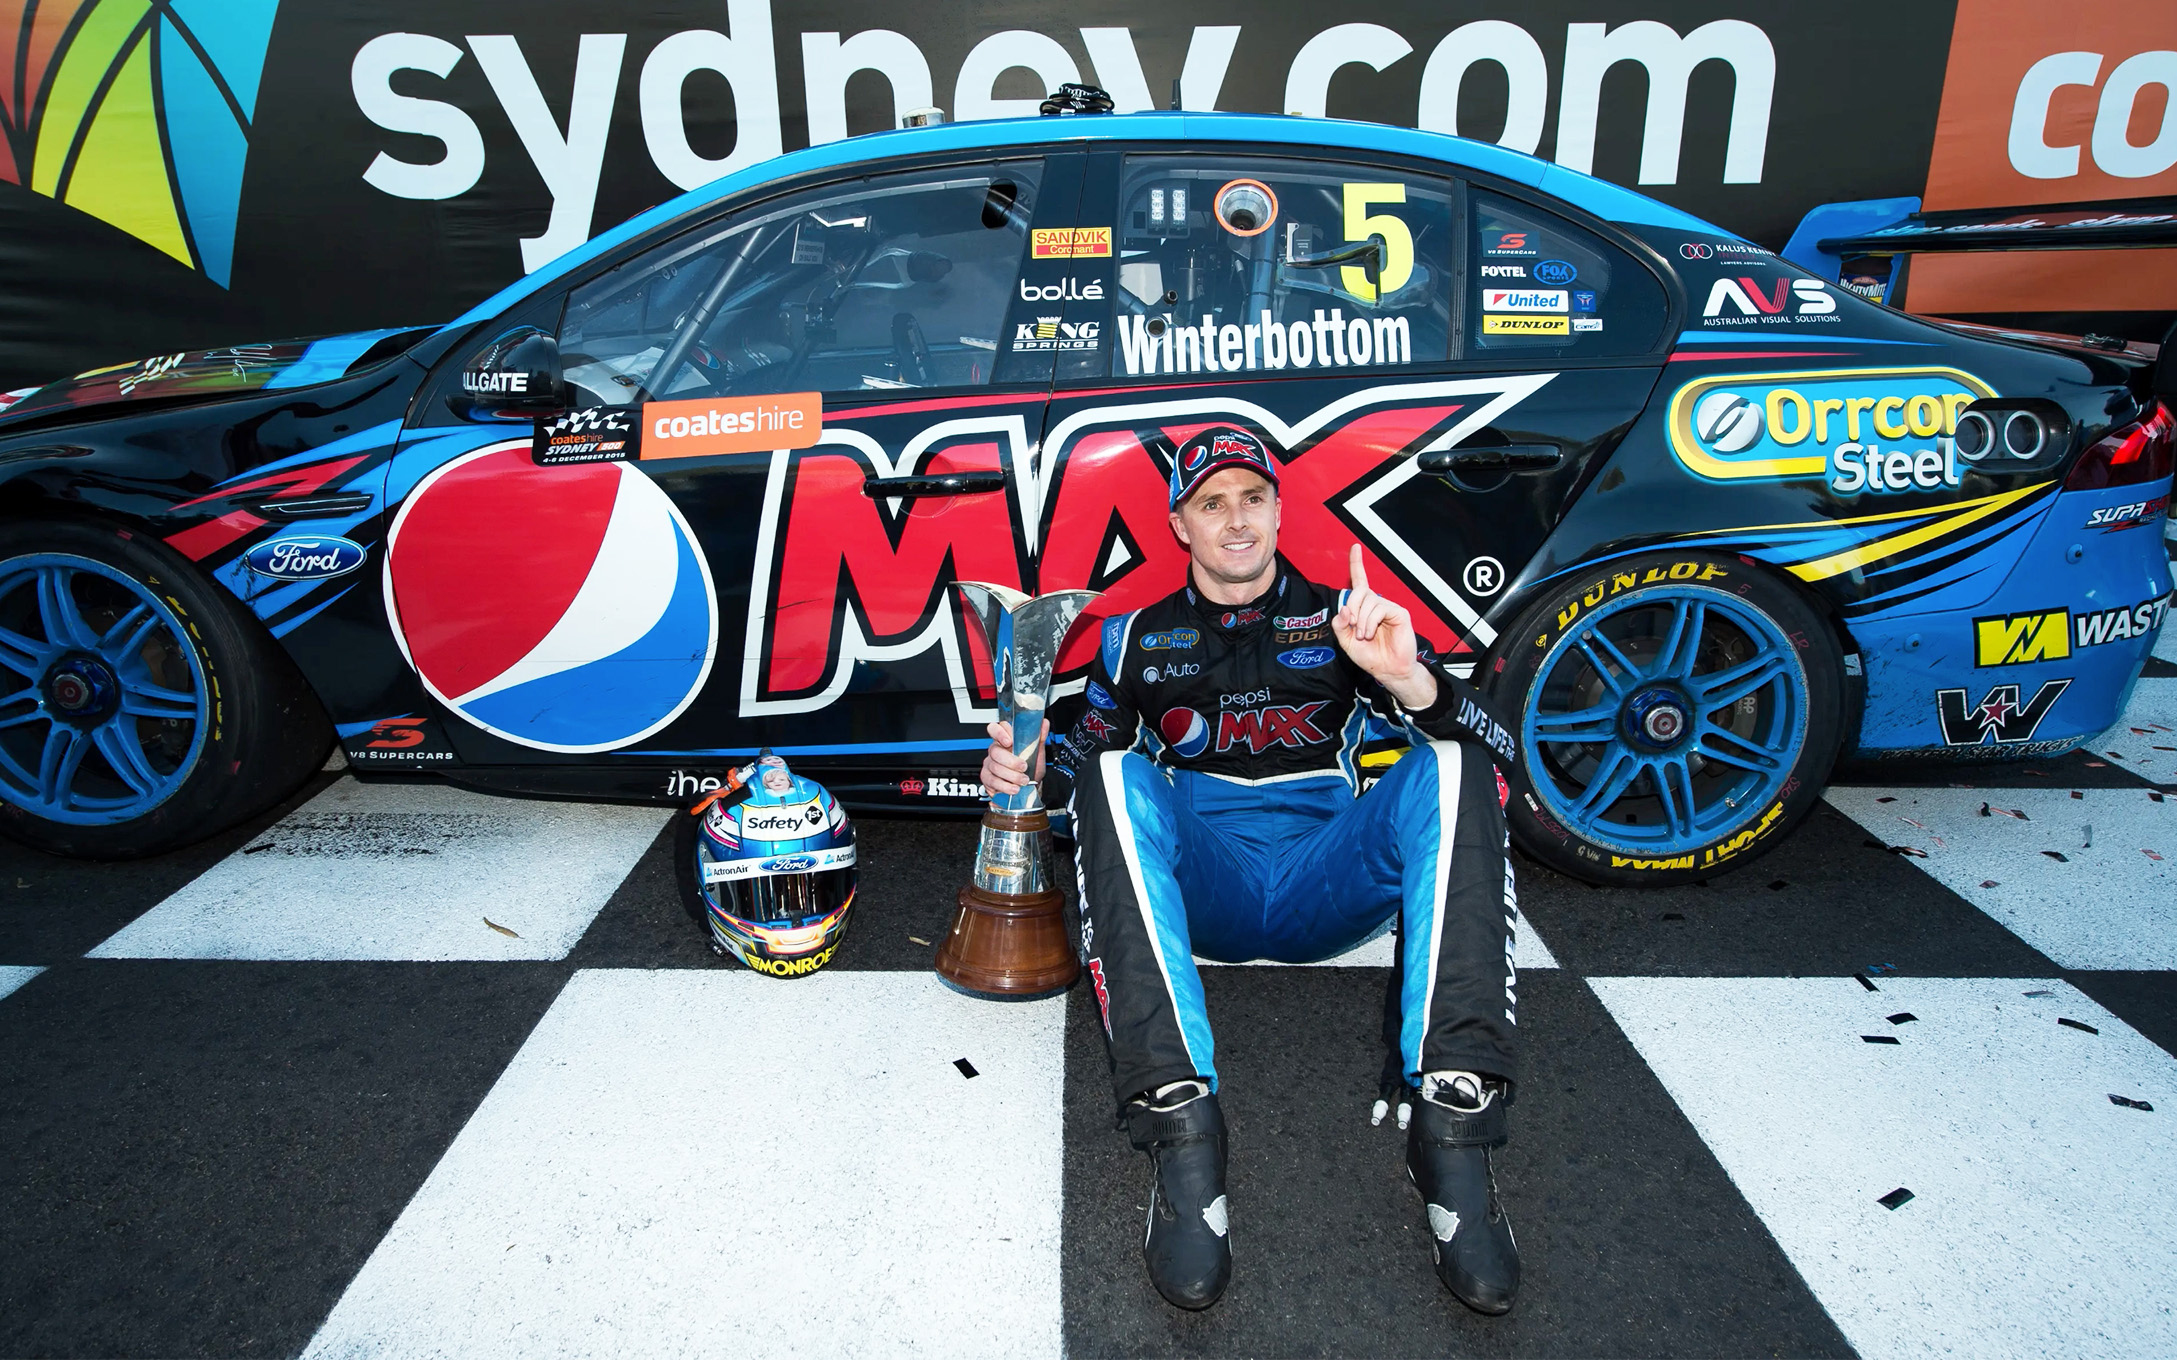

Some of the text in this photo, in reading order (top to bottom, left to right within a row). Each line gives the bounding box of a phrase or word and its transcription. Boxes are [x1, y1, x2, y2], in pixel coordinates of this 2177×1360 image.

[1036, 231, 1108, 244] SANDVIK
[1340, 183, 1416, 305] 5
[1050, 244, 1094, 254] Coromant
[1716, 244, 1747, 253] KALUS
[1481, 266, 1527, 277] FOXTEL
[1020, 277, 1104, 302] bollé
[1702, 277, 1837, 316] AVS
[1508, 293, 1560, 308] United
[1500, 321, 1564, 329] DUNLOP
[1703, 315, 1841, 327] AUSTRALIAN VISUAL SOLUTIONS
[1013, 341, 1098, 349] SPRINGS
[1118, 308, 1411, 377] Winterbottom
[545, 441, 622, 455] SYDNEY 500
[558, 454, 603, 462] DECEMBER
[1831, 438, 1960, 492] Steel
[268, 541, 341, 574] Ford
[739, 373, 1561, 724] MAX
[1557, 561, 1729, 631] DUNLOP
[1286, 610, 1324, 629] Castrol
[1274, 624, 1331, 644] EDGE
[1169, 640, 1192, 650] teel
[1289, 650, 1324, 665] Ford
[1219, 686, 1271, 709] pepsi
[1083, 711, 1118, 743] MAX
[1215, 699, 1331, 755] MAX
[1456, 697, 1508, 755] LIVE LIFE
[350, 751, 454, 760] V8 SUPERCARS
[747, 808, 822, 832] Safety 1st
[713, 865, 749, 876] ActronAir
[771, 857, 809, 871] Ford
[758, 947, 834, 976] MONROE
